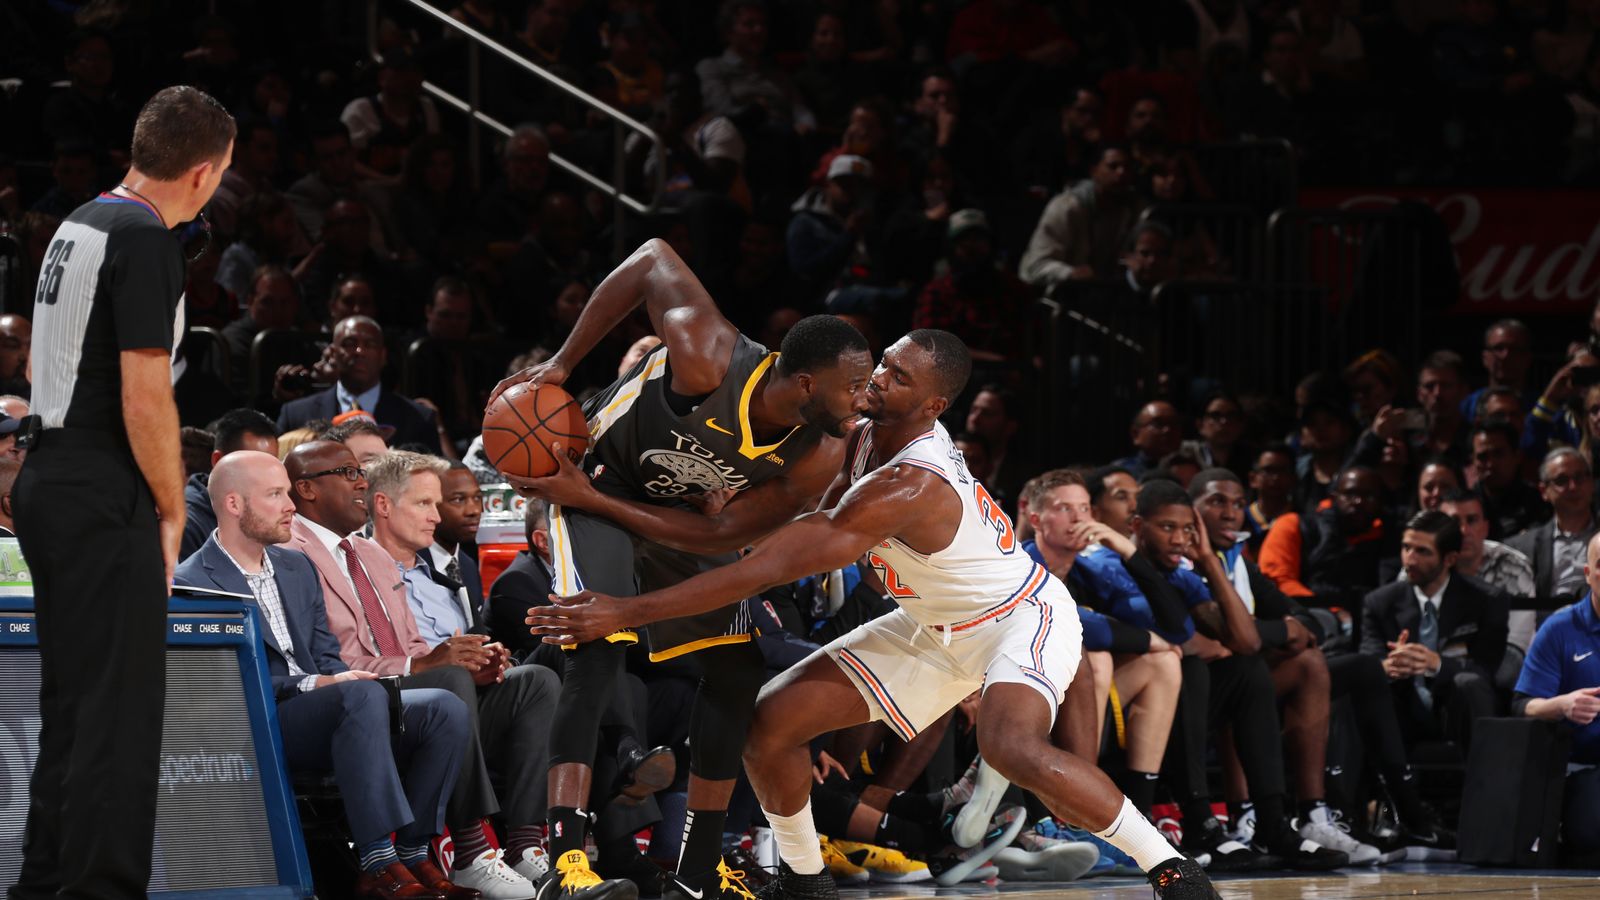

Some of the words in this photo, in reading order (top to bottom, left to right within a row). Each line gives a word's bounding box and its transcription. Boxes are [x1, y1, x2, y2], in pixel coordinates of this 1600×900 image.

[37, 239, 75, 305] 36
[644, 474, 688, 496] 23
[10, 623, 30, 633] CHASE
[173, 623, 192, 633] CHASE
[199, 623, 220, 633] CHASE
[225, 624, 244, 635] CHASE
